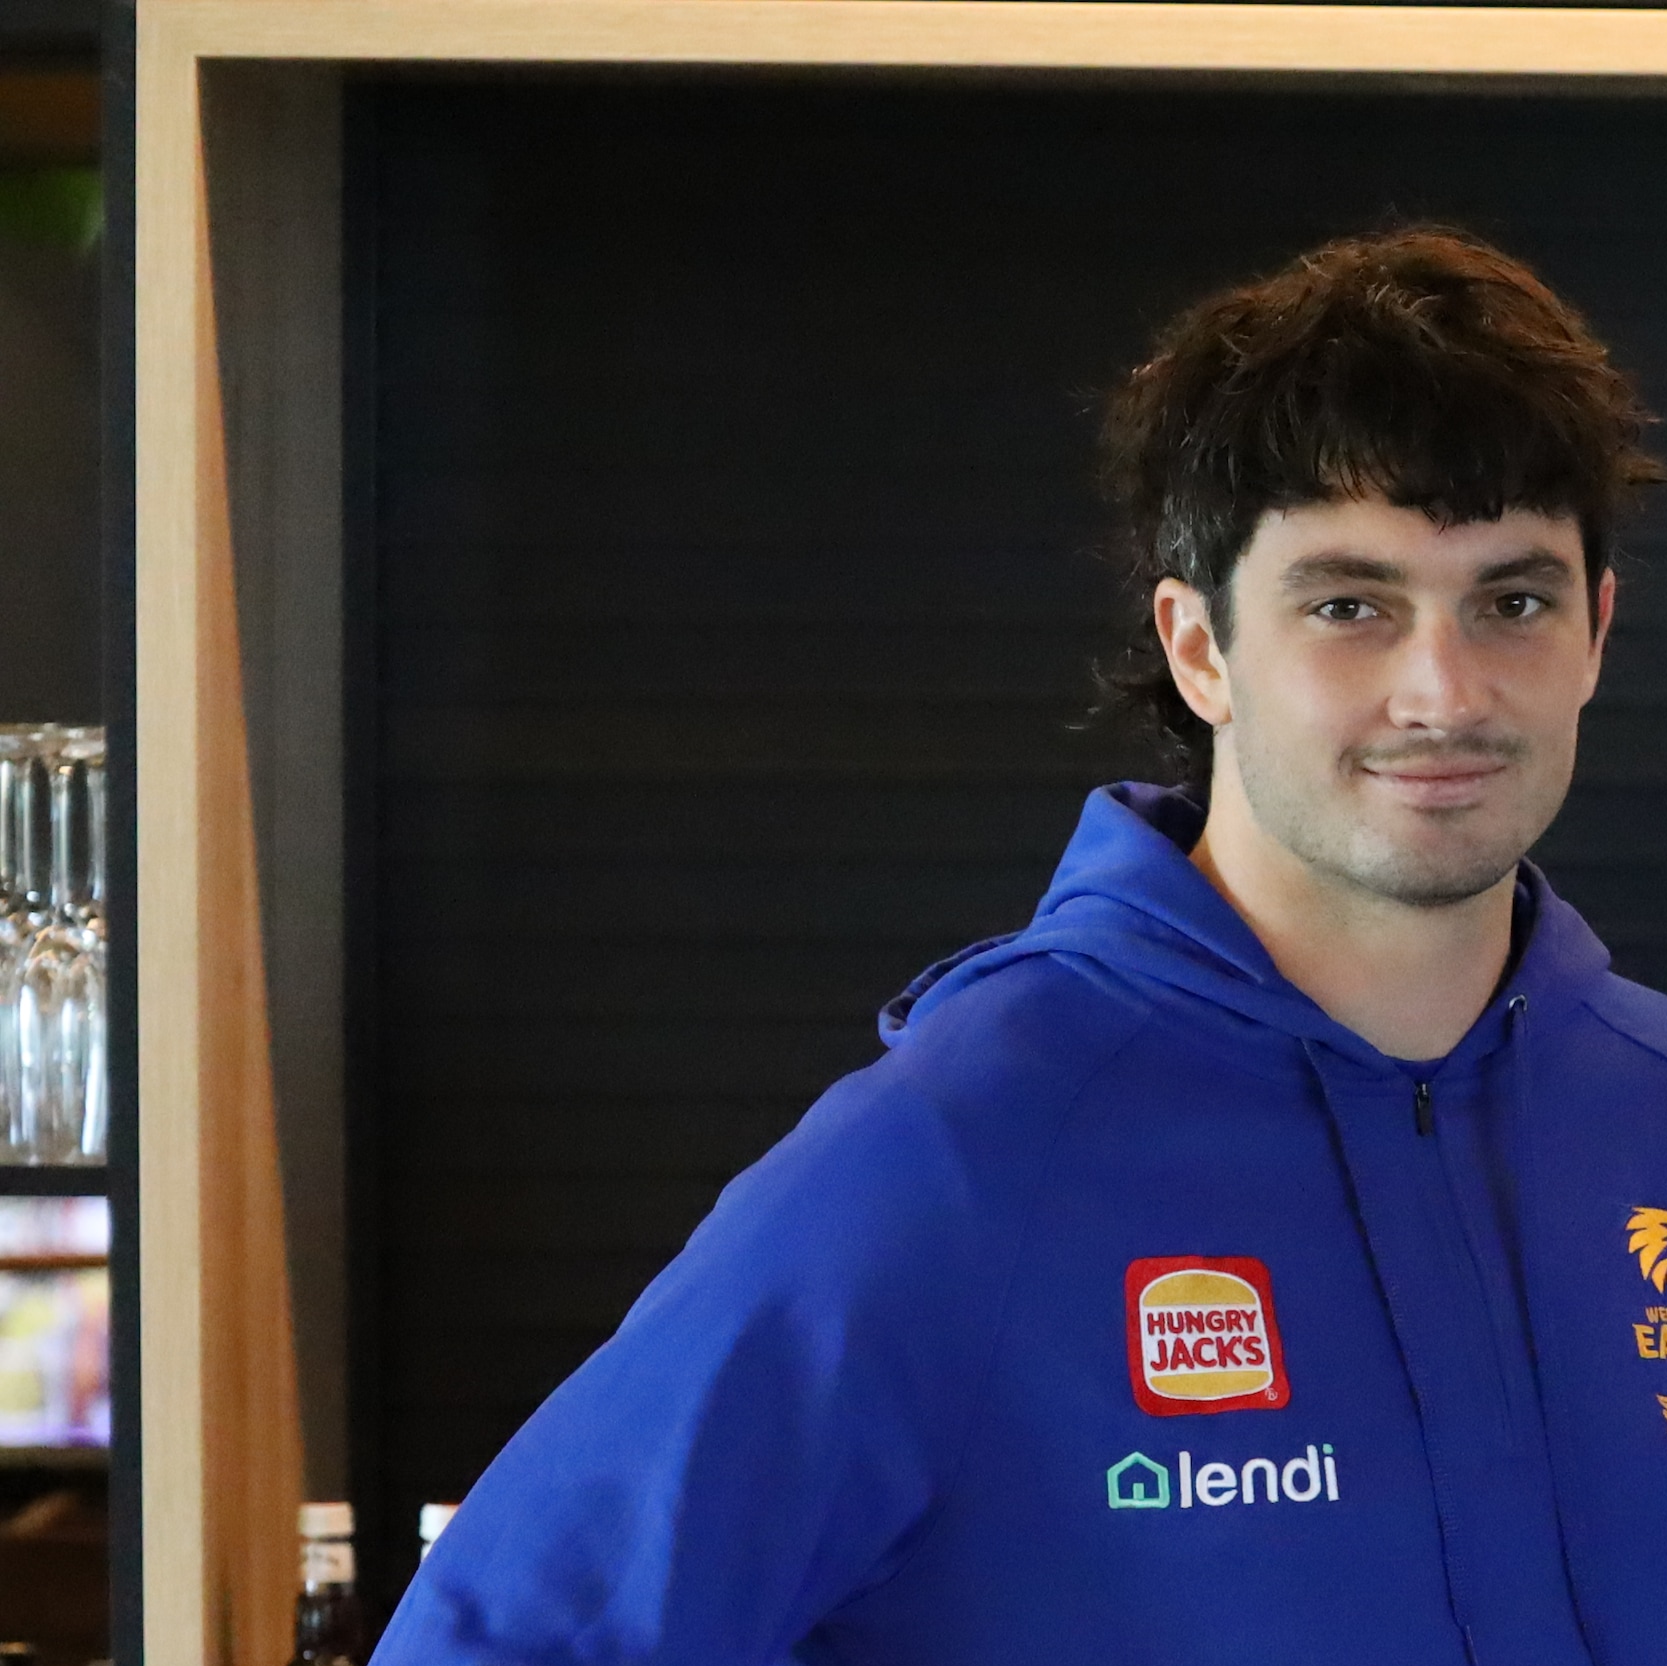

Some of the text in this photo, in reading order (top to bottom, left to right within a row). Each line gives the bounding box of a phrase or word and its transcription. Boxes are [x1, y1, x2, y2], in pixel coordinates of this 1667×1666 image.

[1147, 1310, 1257, 1335] HUNGRY
[1150, 1336, 1265, 1371] JACK'S
[1179, 1444, 1340, 1508] lendi
